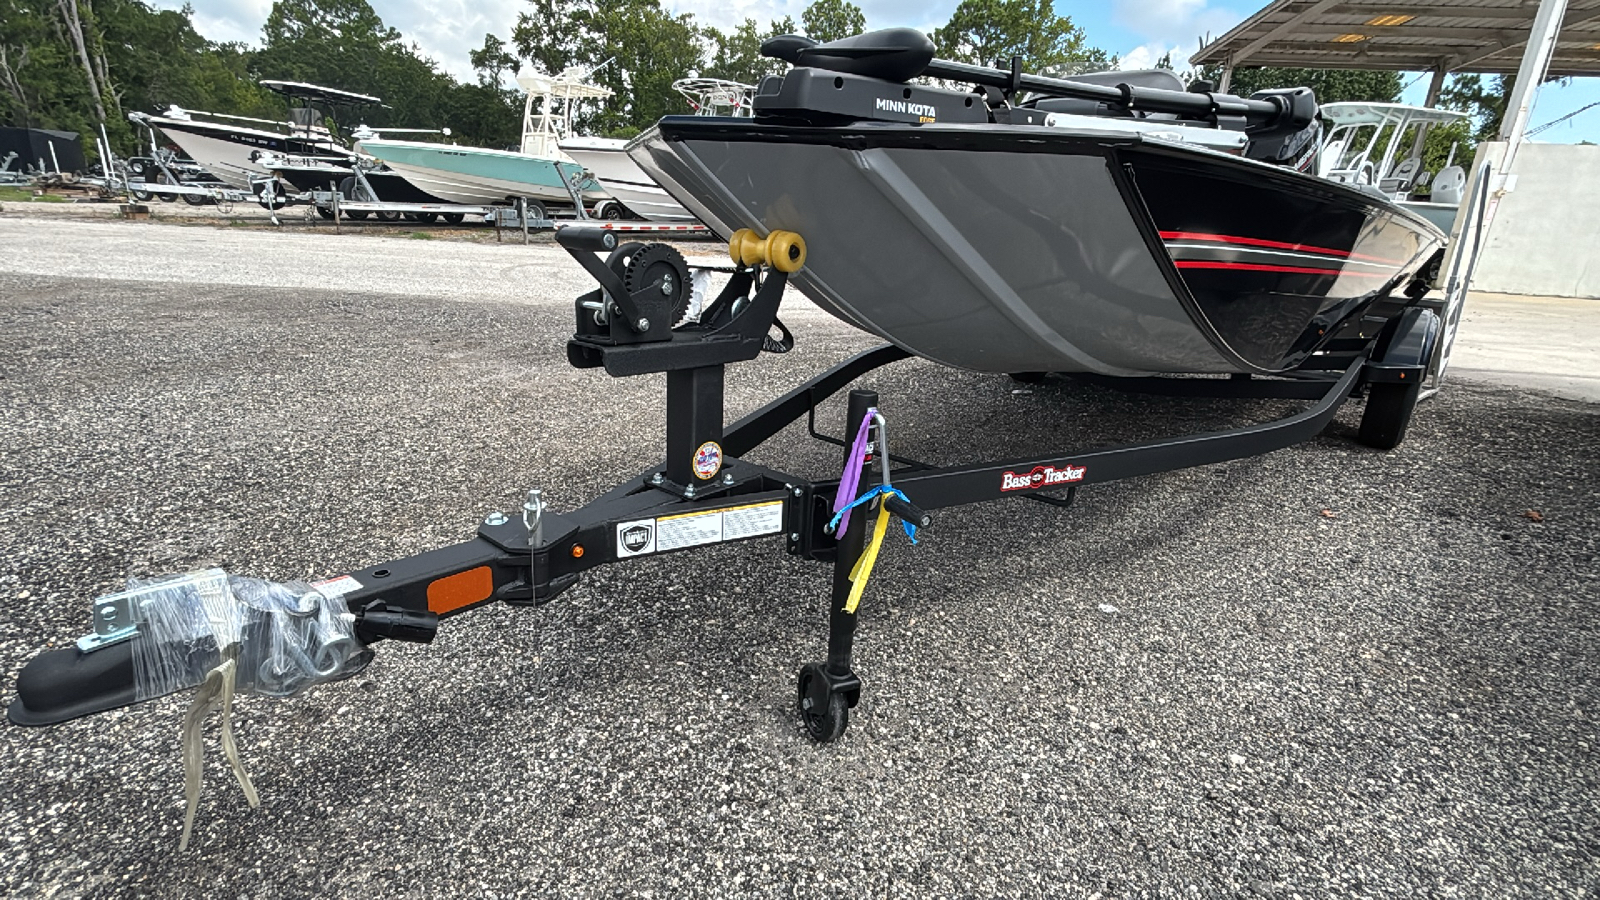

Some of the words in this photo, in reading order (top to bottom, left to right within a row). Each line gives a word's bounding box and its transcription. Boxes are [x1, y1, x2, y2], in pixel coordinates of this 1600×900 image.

[876, 97, 906, 113] MINN
[907, 102, 936, 117] KOTA
[1002, 473, 1031, 489] Bass
[1044, 467, 1084, 483] Tracker
